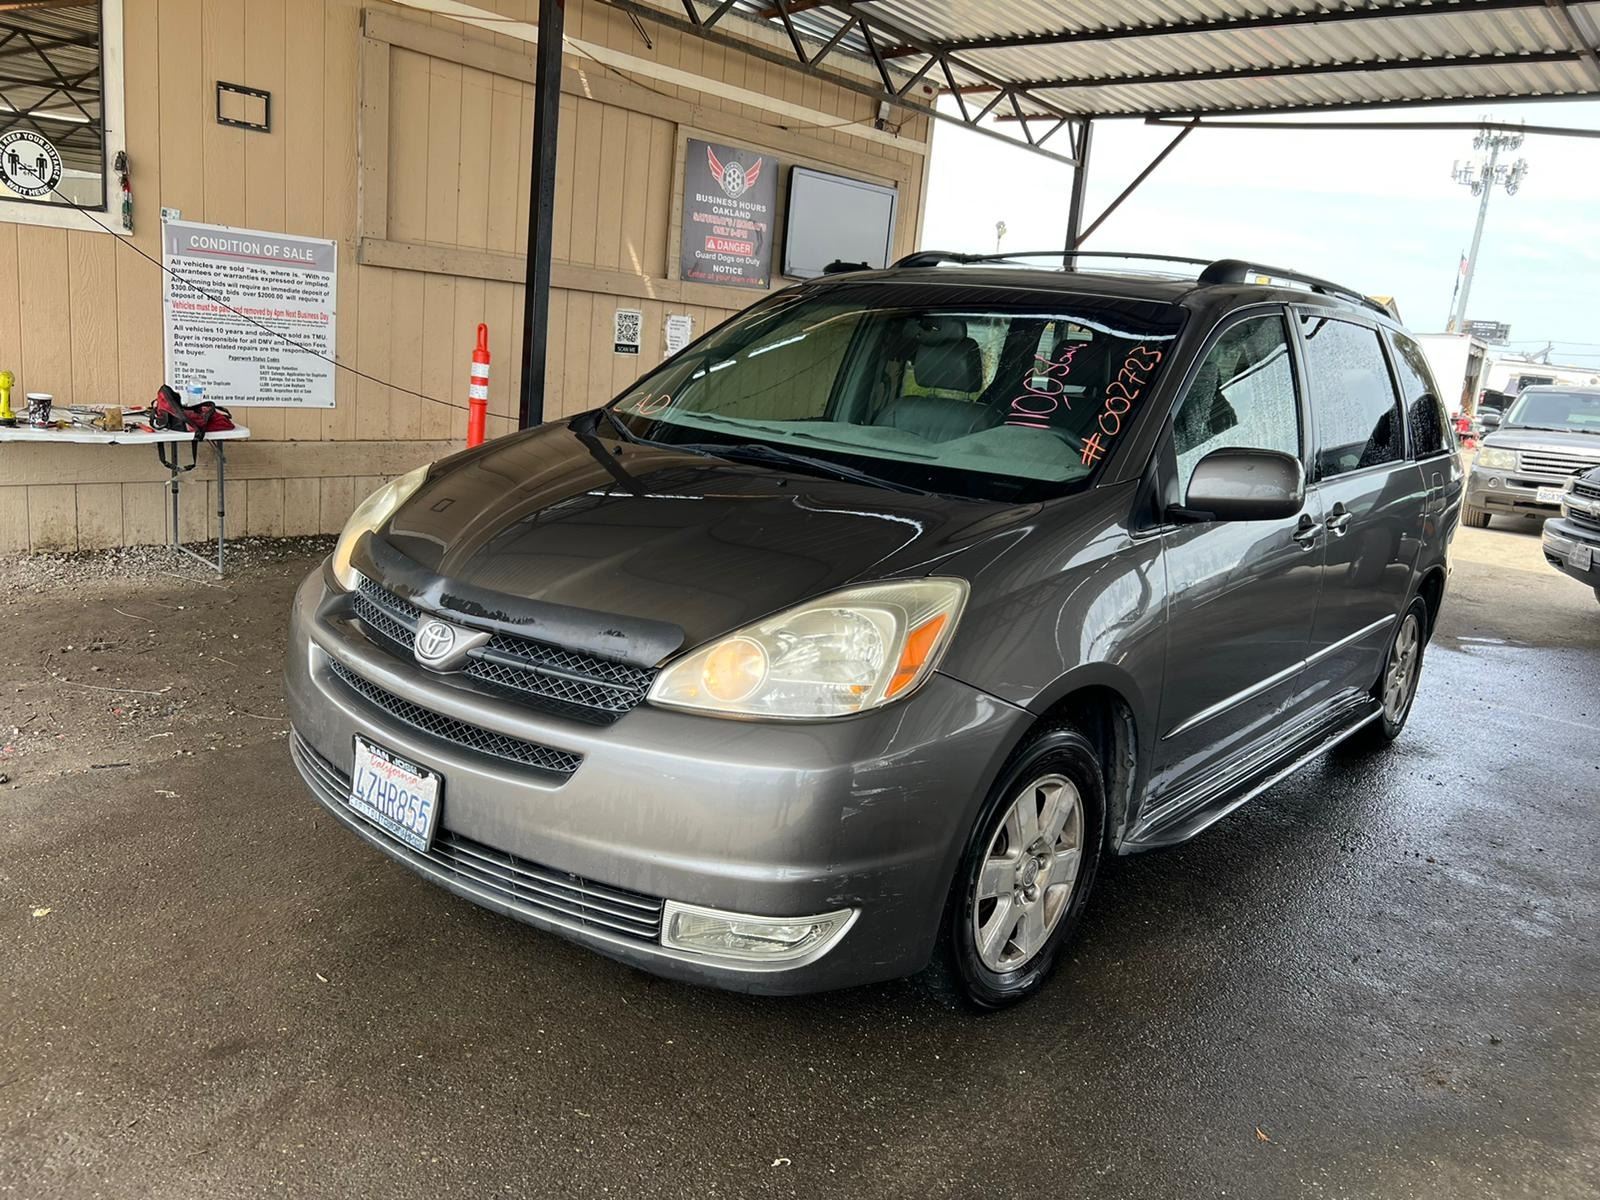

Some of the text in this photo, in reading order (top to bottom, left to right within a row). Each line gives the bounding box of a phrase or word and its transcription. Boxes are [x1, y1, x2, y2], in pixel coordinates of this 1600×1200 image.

[3, 133, 21, 146] KEEP
[23, 133, 44, 146] YOUR
[44, 144, 60, 180] DISTANCE
[7, 180, 51, 196] WAIT HERE
[695, 193, 767, 213] BUSINESS HOURS
[712, 206, 751, 219] OAKLAND
[190, 235, 313, 261] CONDITION OF SALE
[716, 240, 751, 254] DANGER
[695, 250, 716, 260] Guard
[717, 253, 735, 264] Dogs
[745, 257, 761, 268] Duty
[183, 260, 213, 269] vehicles
[270, 269, 290, 277] where
[712, 264, 743, 275] NOTICE
[171, 267, 211, 277] guarantees
[223, 272, 259, 281] warranties
[261, 276, 294, 285] expressed
[171, 292, 195, 300] deposit
[240, 283, 260, 291] require
[271, 285, 300, 294] immediate
[302, 287, 323, 297] deposit
[172, 300, 195, 310] Vehicles
[197, 303, 210, 311] must
[298, 295, 318, 303] require
[185, 325, 214, 333] vehicles
[225, 328, 243, 336] years
[174, 333, 193, 341] Buyer
[202, 336, 238, 344] responsible
[1080, 346, 1162, 466] #002723
